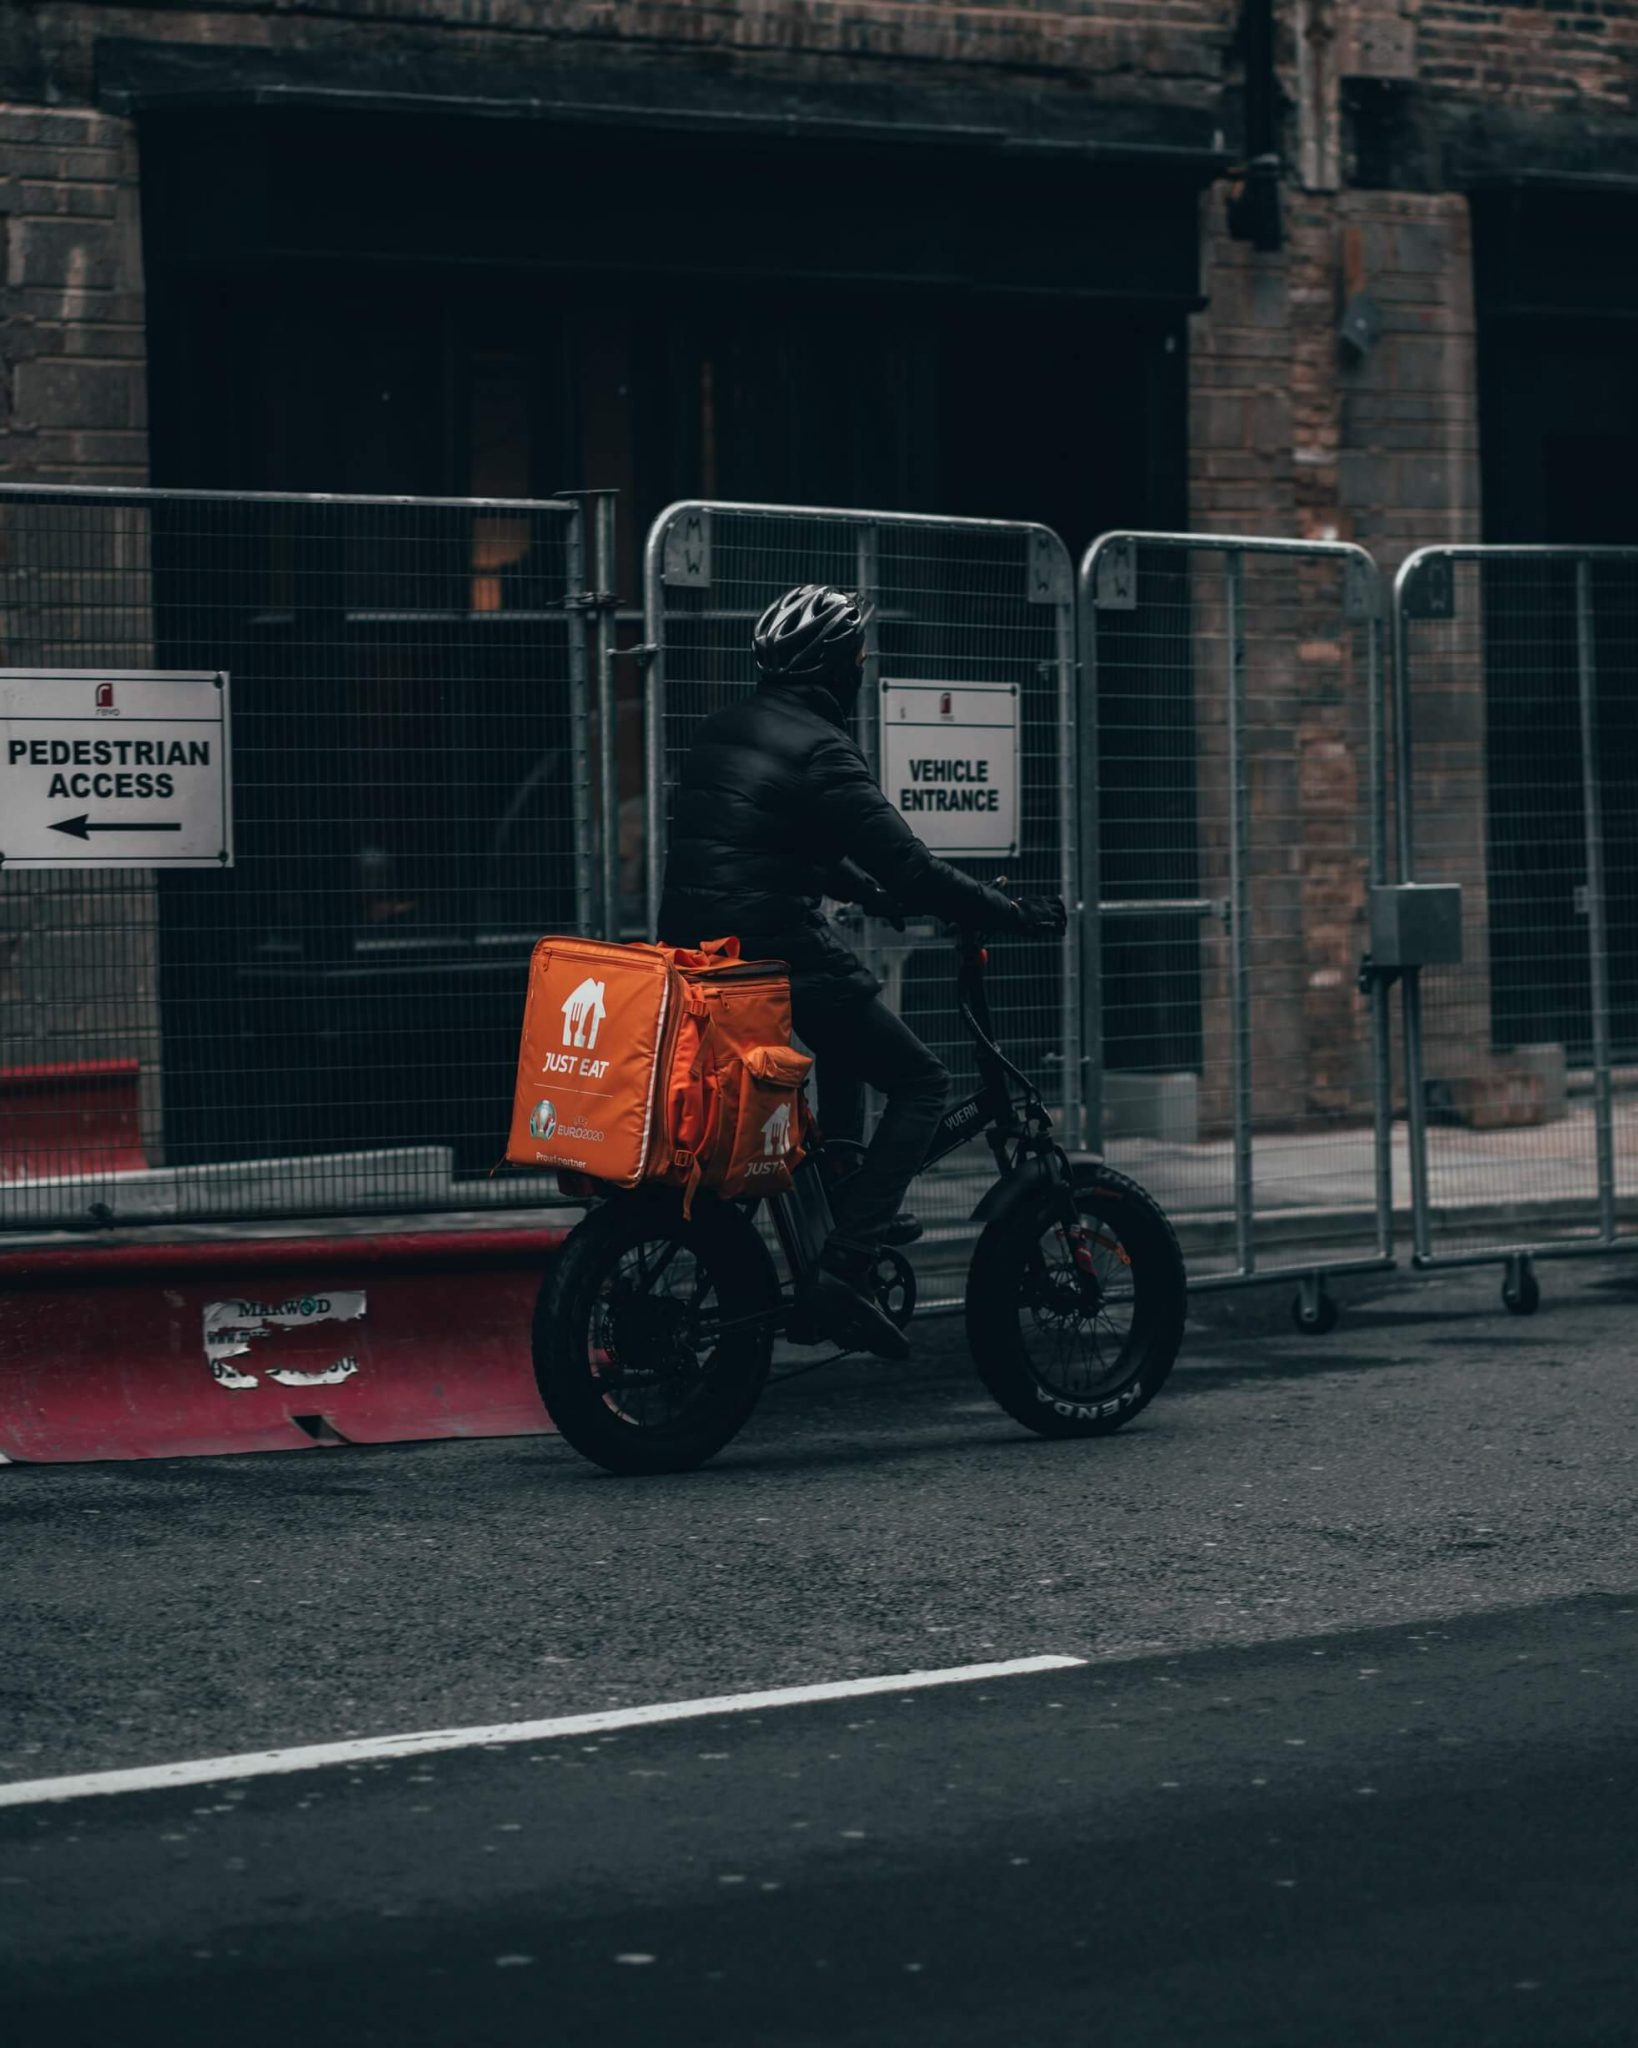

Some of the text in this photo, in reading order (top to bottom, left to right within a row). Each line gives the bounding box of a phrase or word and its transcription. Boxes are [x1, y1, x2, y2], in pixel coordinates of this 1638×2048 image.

[9, 740, 209, 765] PEDESTRIAN
[910, 760, 988, 782] VEHICLE
[48, 773, 174, 798] ACCESS
[901, 789, 998, 811] ENTRANCE
[542, 1052, 610, 1079] JUST EAT
[744, 1160, 780, 1178] JUST
[1036, 1381, 1141, 1419] KENDA
